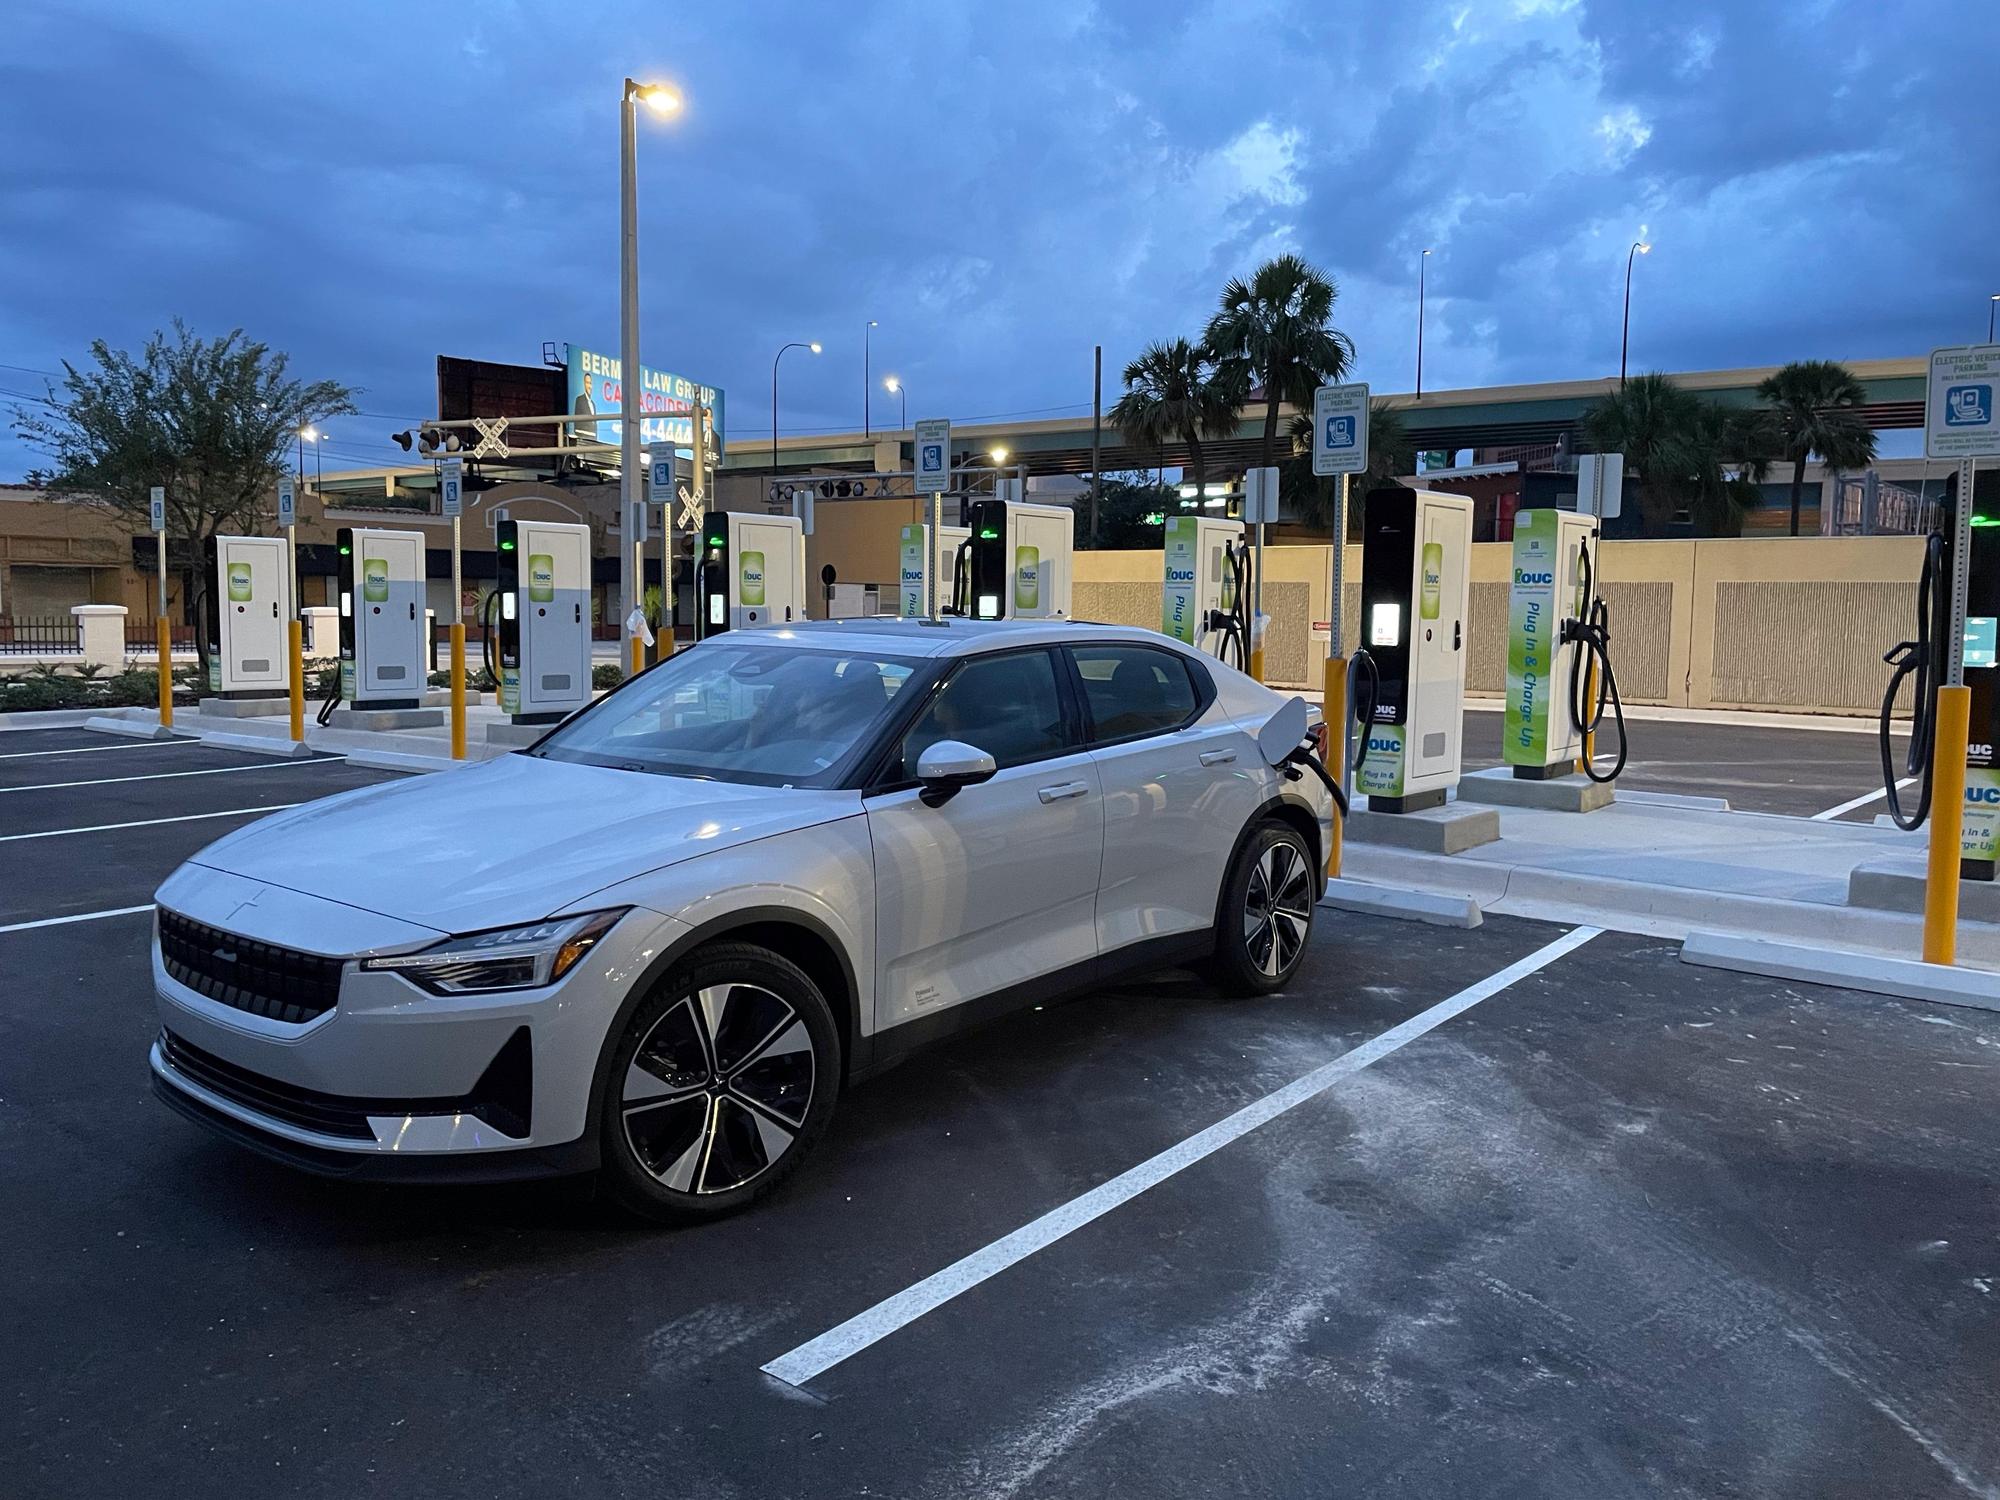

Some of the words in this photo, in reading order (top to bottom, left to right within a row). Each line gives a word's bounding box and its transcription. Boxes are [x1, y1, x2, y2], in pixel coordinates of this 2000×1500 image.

[582, 351, 621, 380] BERM
[645, 369, 671, 393] LAW
[604, 381, 622, 403] CA
[747, 573, 762, 581] OUC
[905, 571, 923, 580] OUC
[1171, 570, 1194, 581] OUC
[1521, 573, 1553, 584] OUC
[908, 593, 917, 616] Plug
[1173, 595, 1185, 623] Plug
[1523, 602, 1540, 633] Plug
[1175, 626, 1184, 638] In
[1525, 638, 1538, 650] In
[1524, 656, 1538, 668] &
[1519, 672, 1537, 723] Charge
[1518, 726, 1534, 748] Up
[1369, 738, 1401, 752] OUC
[1967, 743, 1992, 755] UC
[1364, 770, 1378, 780] Plug
[1362, 780, 1386, 789] Charge
[1387, 780, 1398, 790] Up
[1964, 786, 2000, 804] UC
[1968, 828, 1979, 837] In
[1981, 828, 1991, 837] &
[1980, 841, 1994, 852] Up
